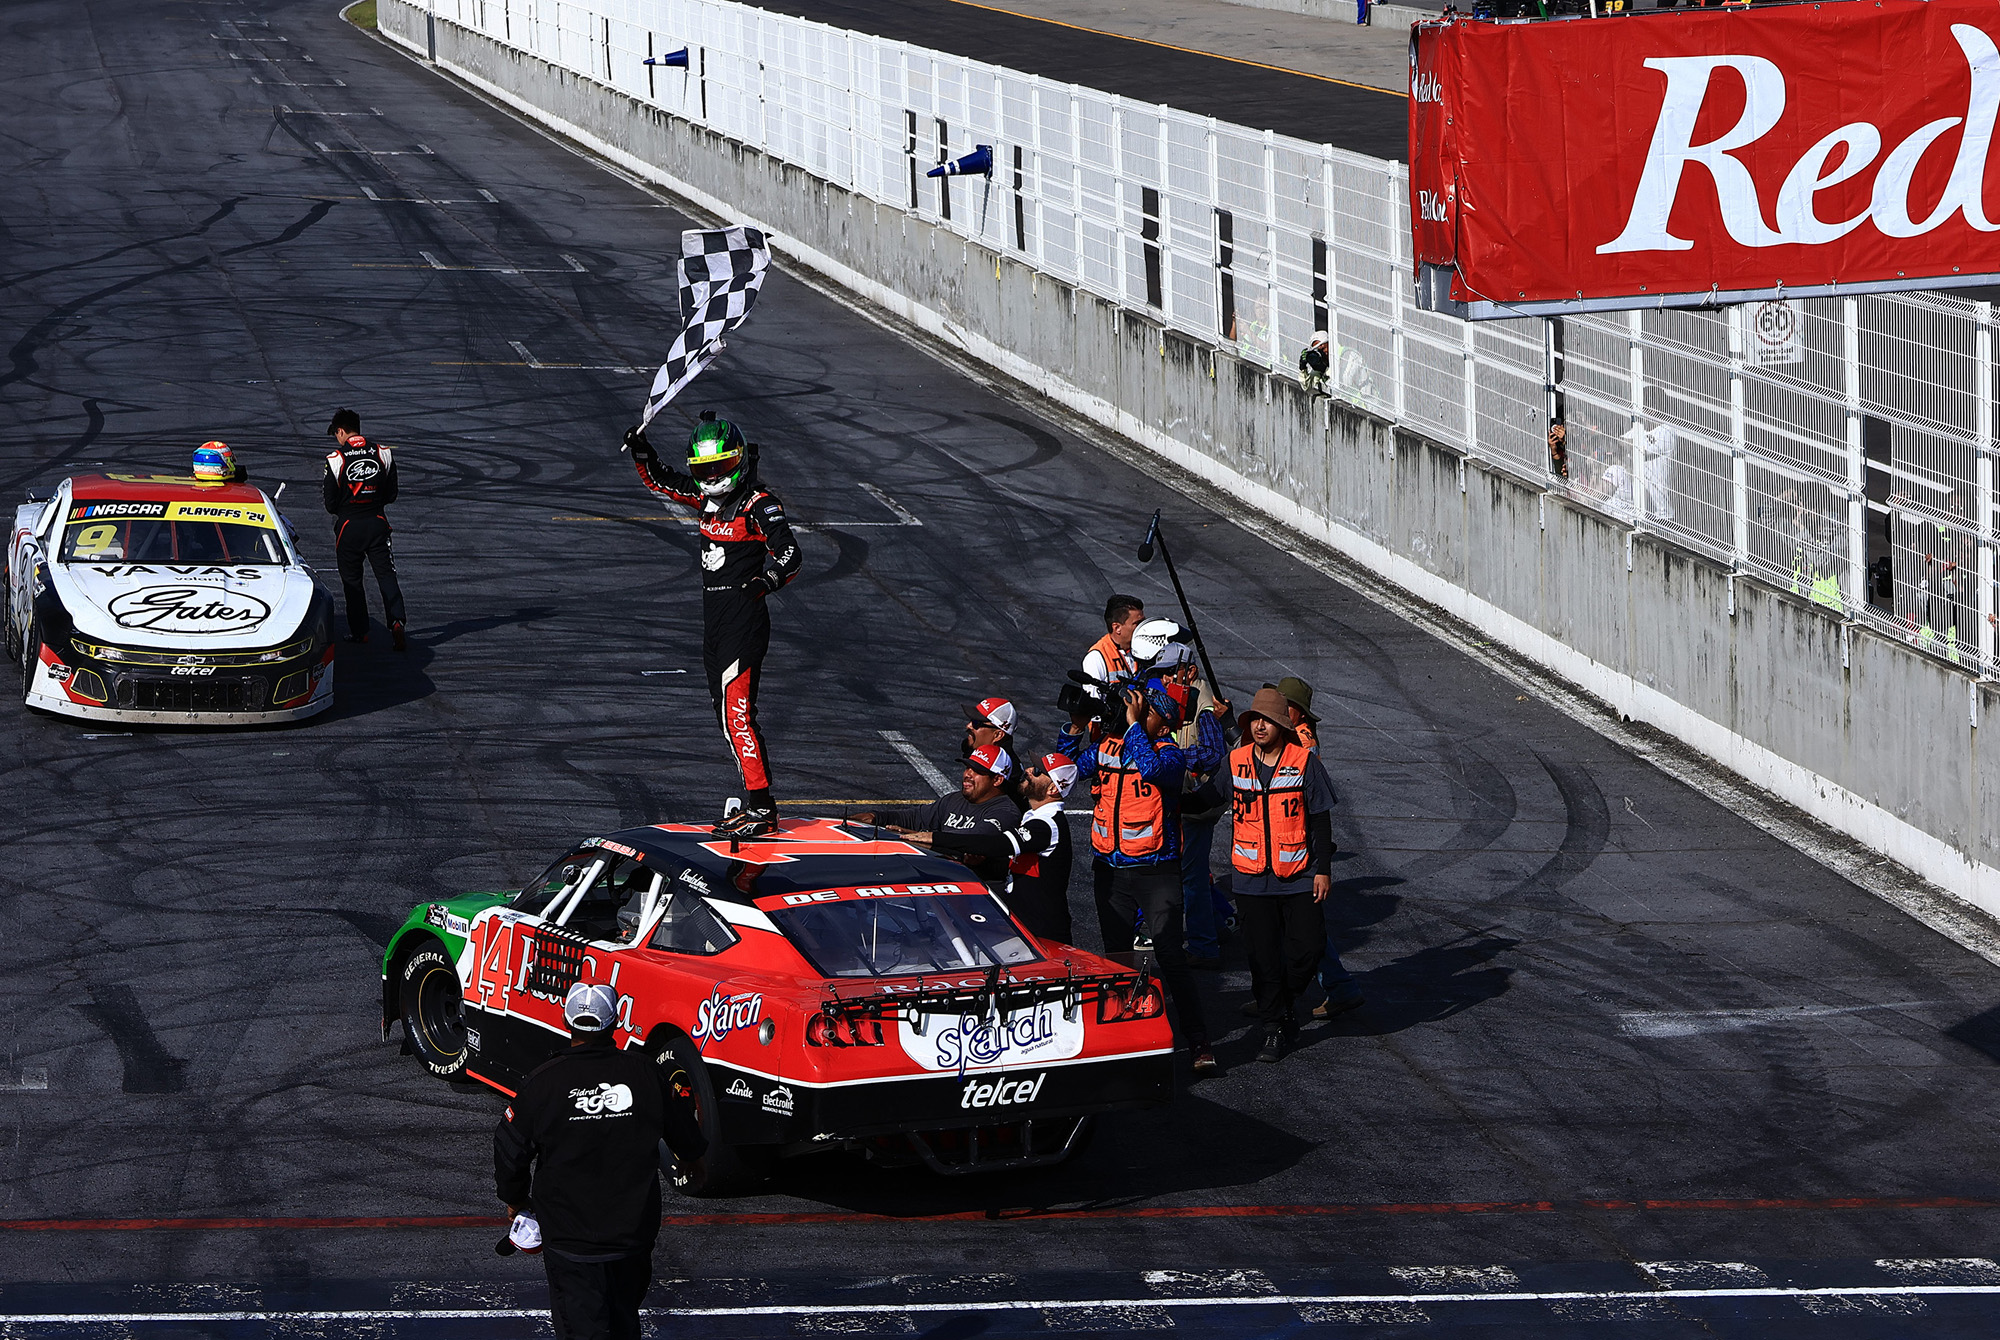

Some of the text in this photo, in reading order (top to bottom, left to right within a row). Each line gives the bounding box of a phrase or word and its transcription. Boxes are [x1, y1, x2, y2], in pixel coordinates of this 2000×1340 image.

[1596, 23, 2000, 254] Red
[344, 448, 367, 457] volaris
[92, 503, 164, 516] NASCAR
[178, 506, 266, 523] PLAYOFFS '24
[73, 524, 117, 557] 9
[130, 589, 256, 625] Gates
[170, 666, 217, 677] telcel
[1108, 740, 1122, 758] TV
[1237, 763, 1252, 779] TV
[1131, 779, 1152, 798] 15
[1281, 797, 1299, 818] 12
[782, 884, 963, 906] DE ALBA
[404, 952, 445, 981] GENERAL
[463, 917, 514, 1013] 14
[957, 974, 1047, 990] Cla
[428, 1047, 468, 1075] GENERAL
[568, 1087, 599, 1098] Sidral
[726, 1079, 753, 1098] Linde
[961, 1073, 1047, 1109] telcel
[575, 1093, 619, 1114] aga
[763, 1094, 794, 1110] Electrolit
